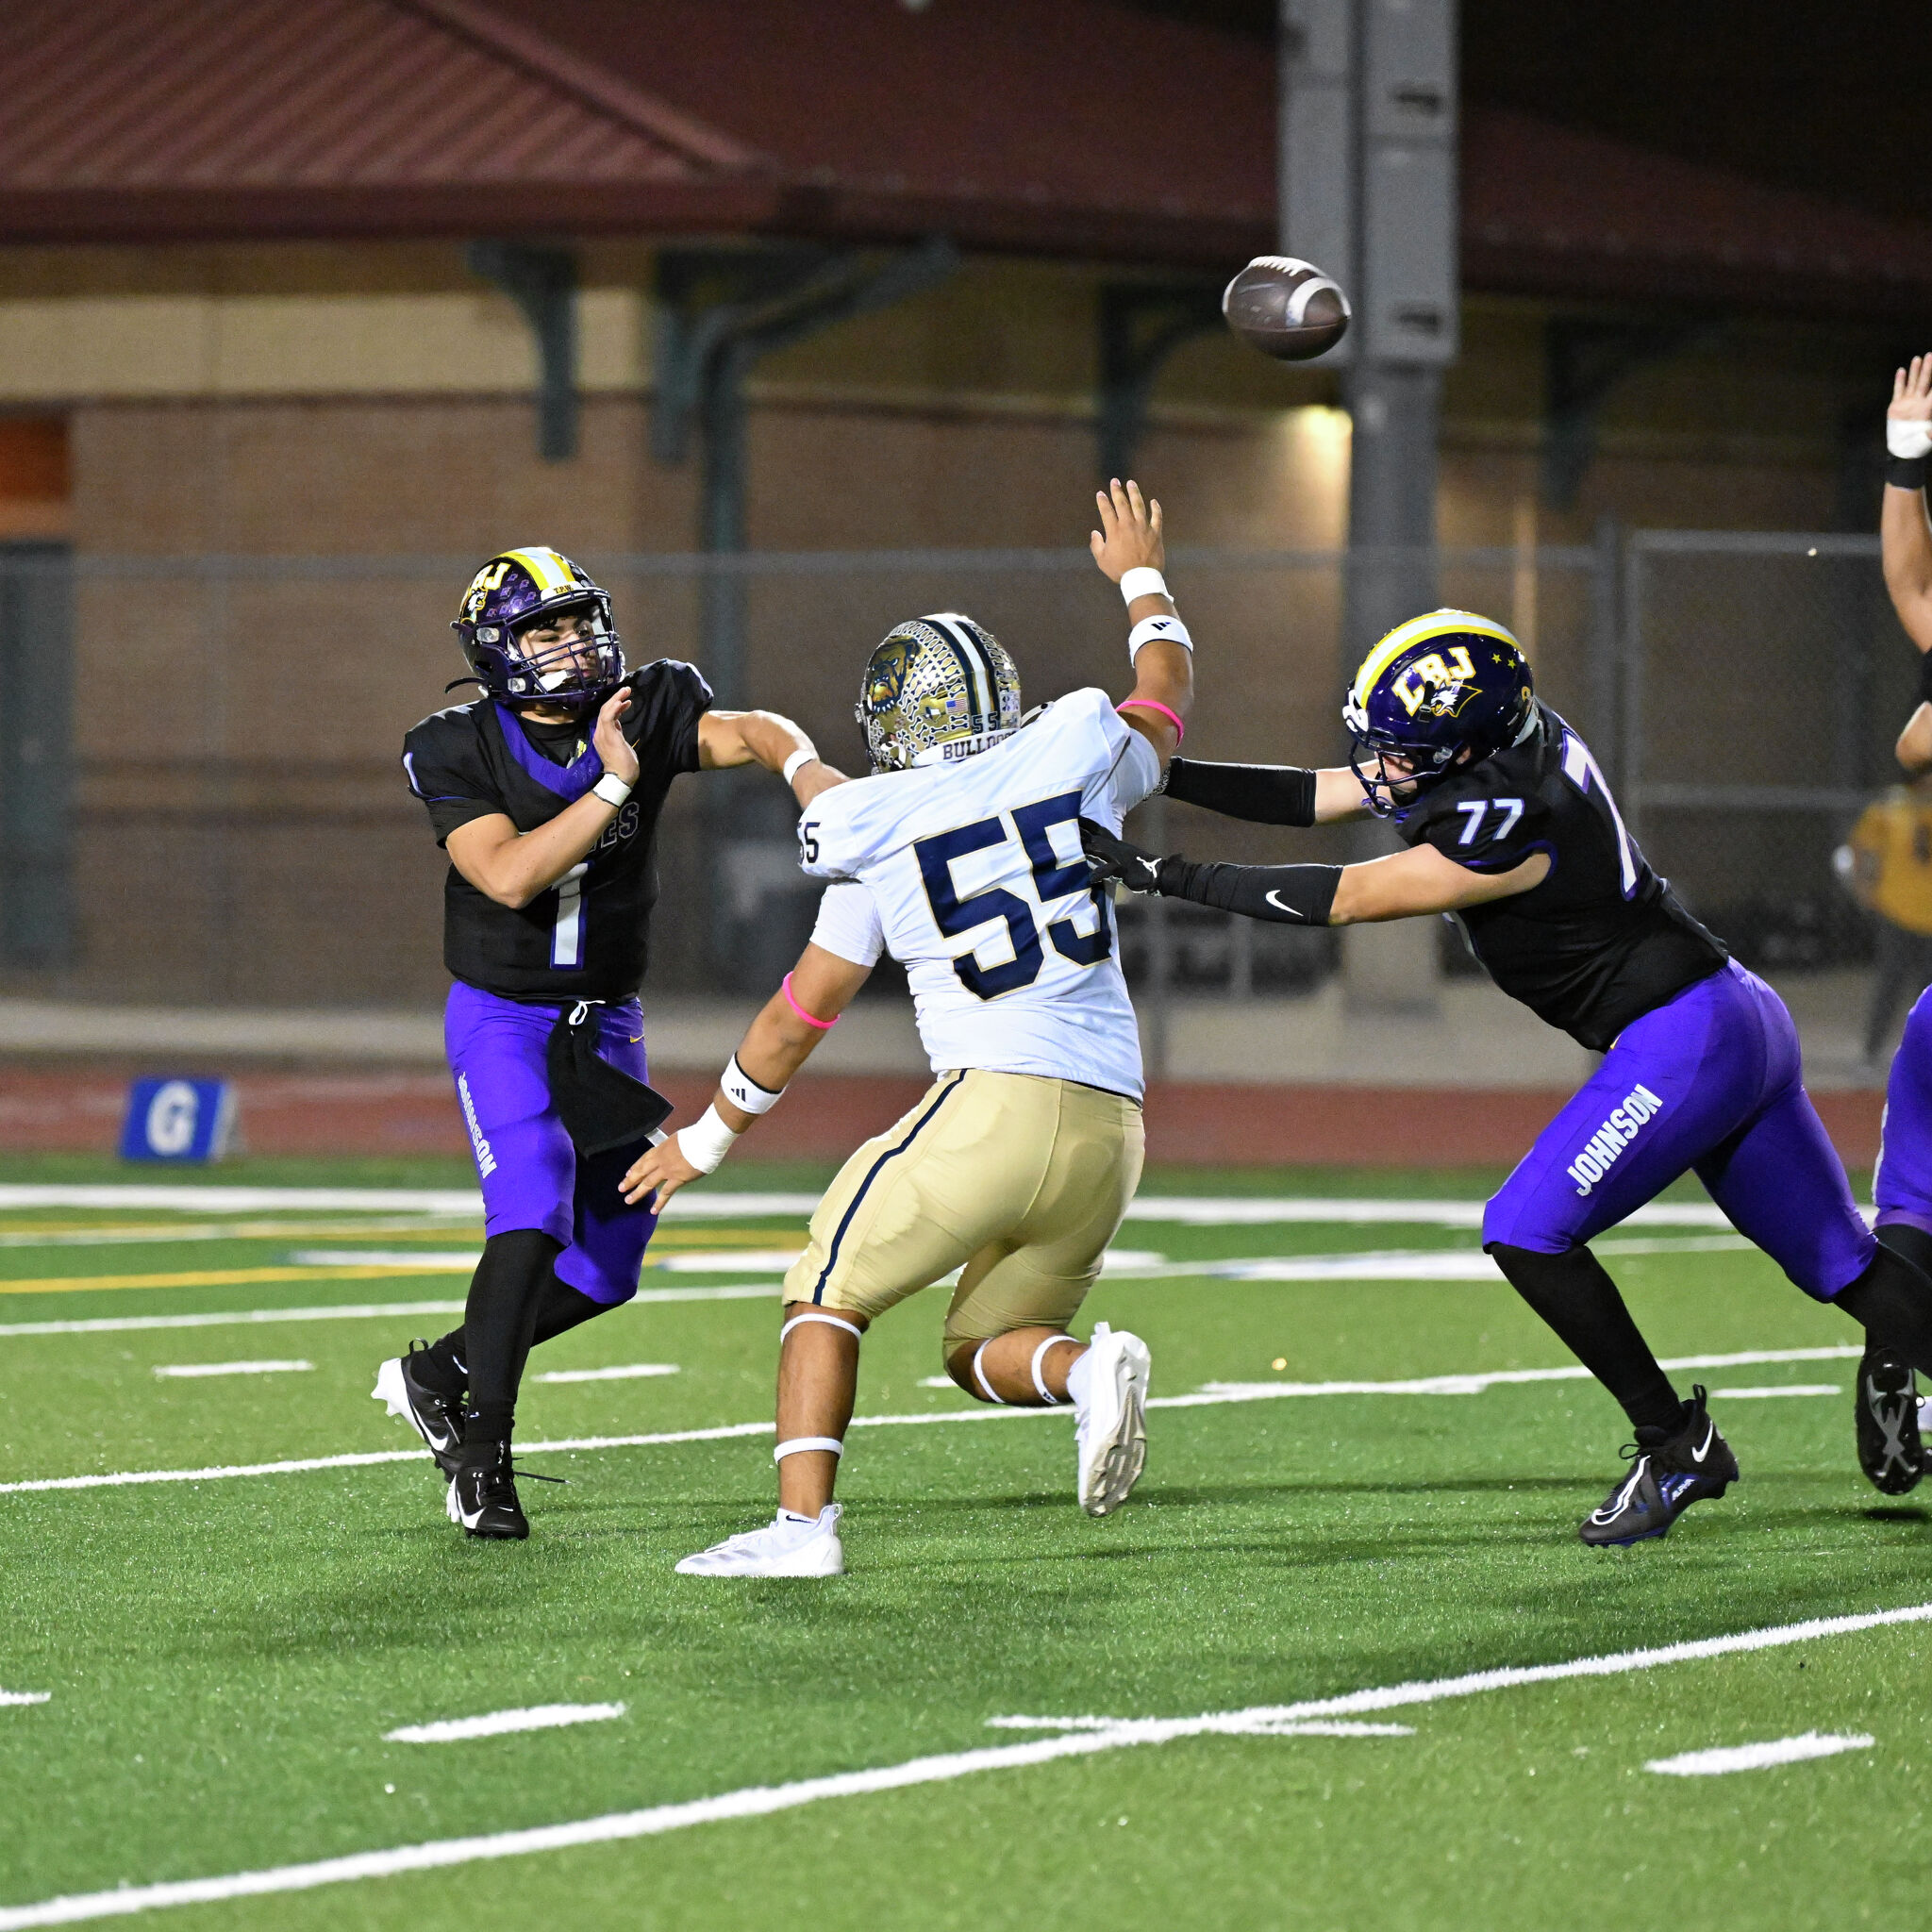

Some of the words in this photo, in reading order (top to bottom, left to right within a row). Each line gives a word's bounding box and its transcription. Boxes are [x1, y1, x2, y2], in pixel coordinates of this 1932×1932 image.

[1391, 646, 1476, 717] LBJ
[972, 711, 999, 735] 55
[797, 822, 821, 865] 5
[1457, 798, 1525, 845] 77
[550, 860, 595, 970] 1
[912, 788, 1112, 1003] 55
[145, 1080, 198, 1157] G
[1567, 1084, 1663, 1196] JOHNSON
